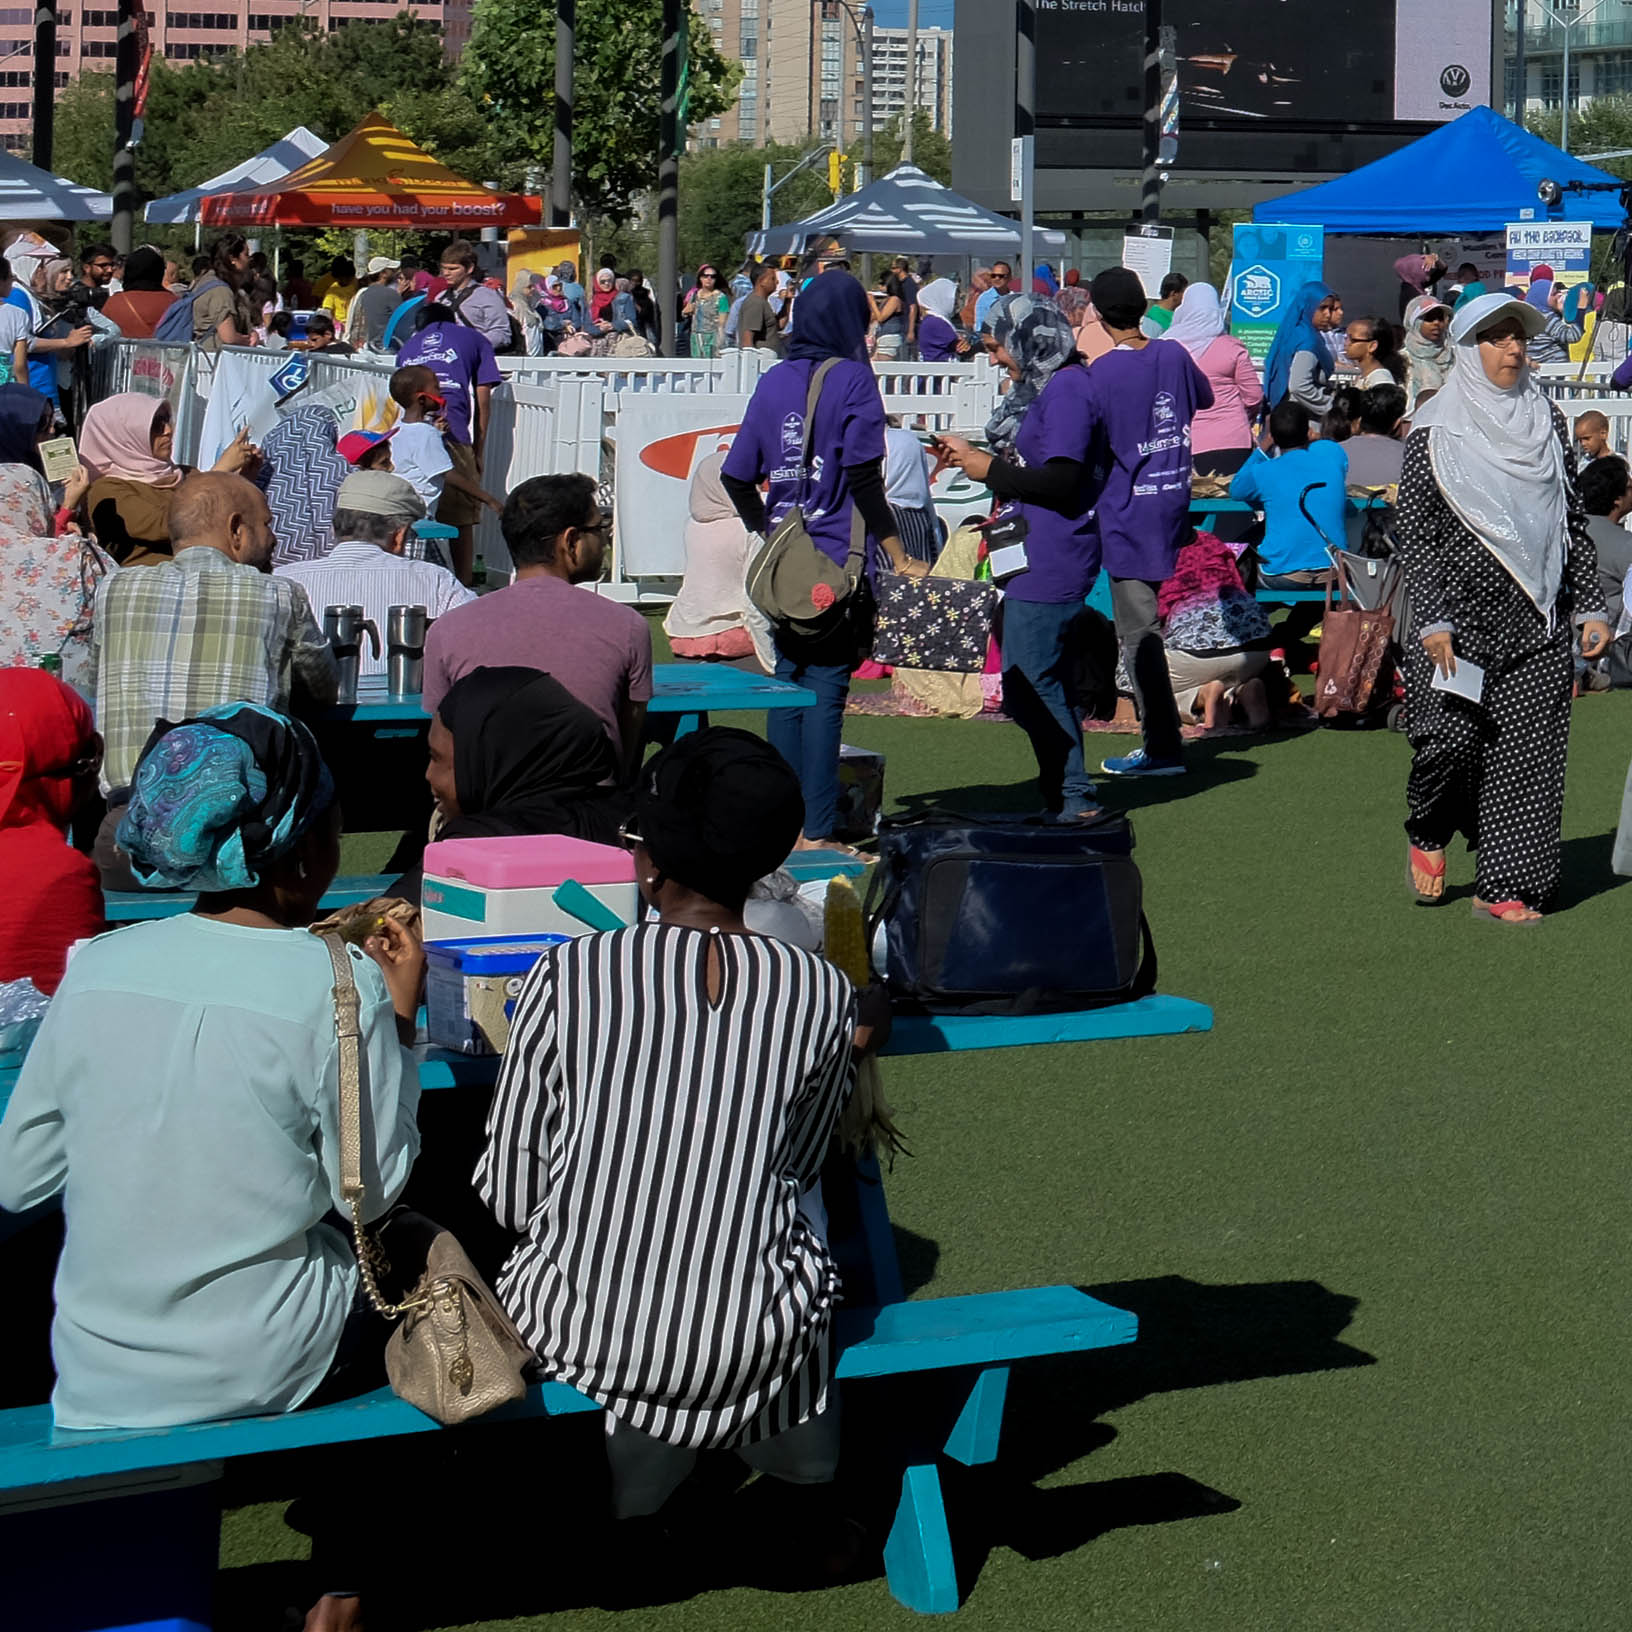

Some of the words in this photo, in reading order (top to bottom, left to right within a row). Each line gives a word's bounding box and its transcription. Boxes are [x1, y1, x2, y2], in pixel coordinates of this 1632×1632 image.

[332, 203, 363, 215] have
[366, 205, 387, 217] you
[393, 203, 418, 215] had
[421, 205, 450, 217] your
[452, 201, 506, 217] boost?
